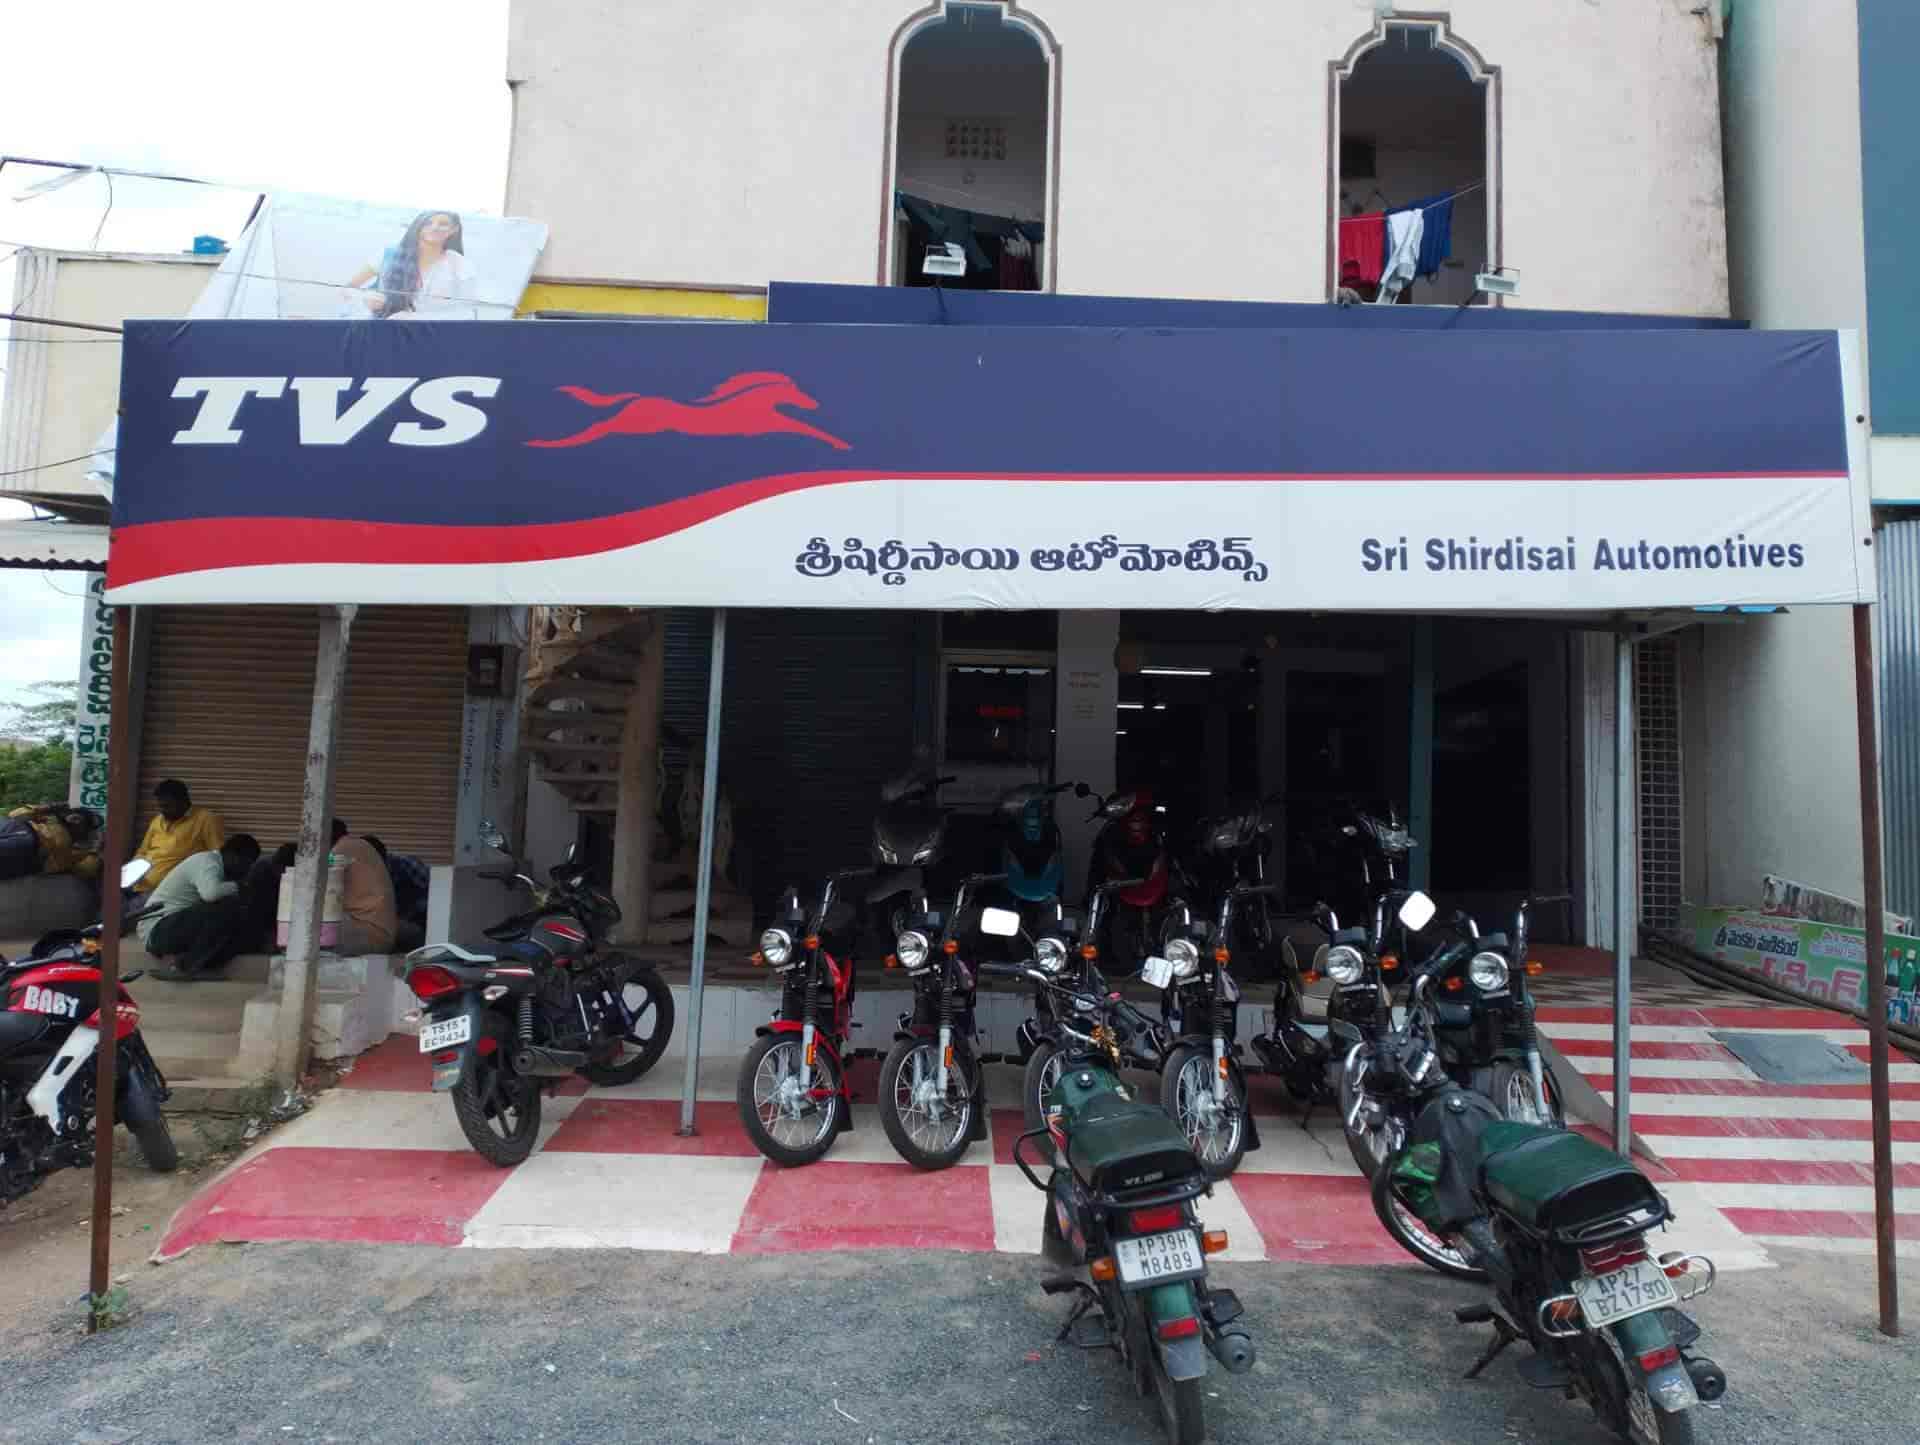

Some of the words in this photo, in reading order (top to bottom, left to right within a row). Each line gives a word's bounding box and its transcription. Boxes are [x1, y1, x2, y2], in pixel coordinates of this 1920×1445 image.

[170, 375, 502, 446] TVS
[1361, 536, 1408, 572] Sri
[1425, 535, 1576, 572] Shirdisai
[1593, 534, 1805, 571] Automotives
[23, 984, 80, 1018] BABY
[1137, 1232, 1188, 1257] AP39H
[1141, 1251, 1193, 1277] M8489
